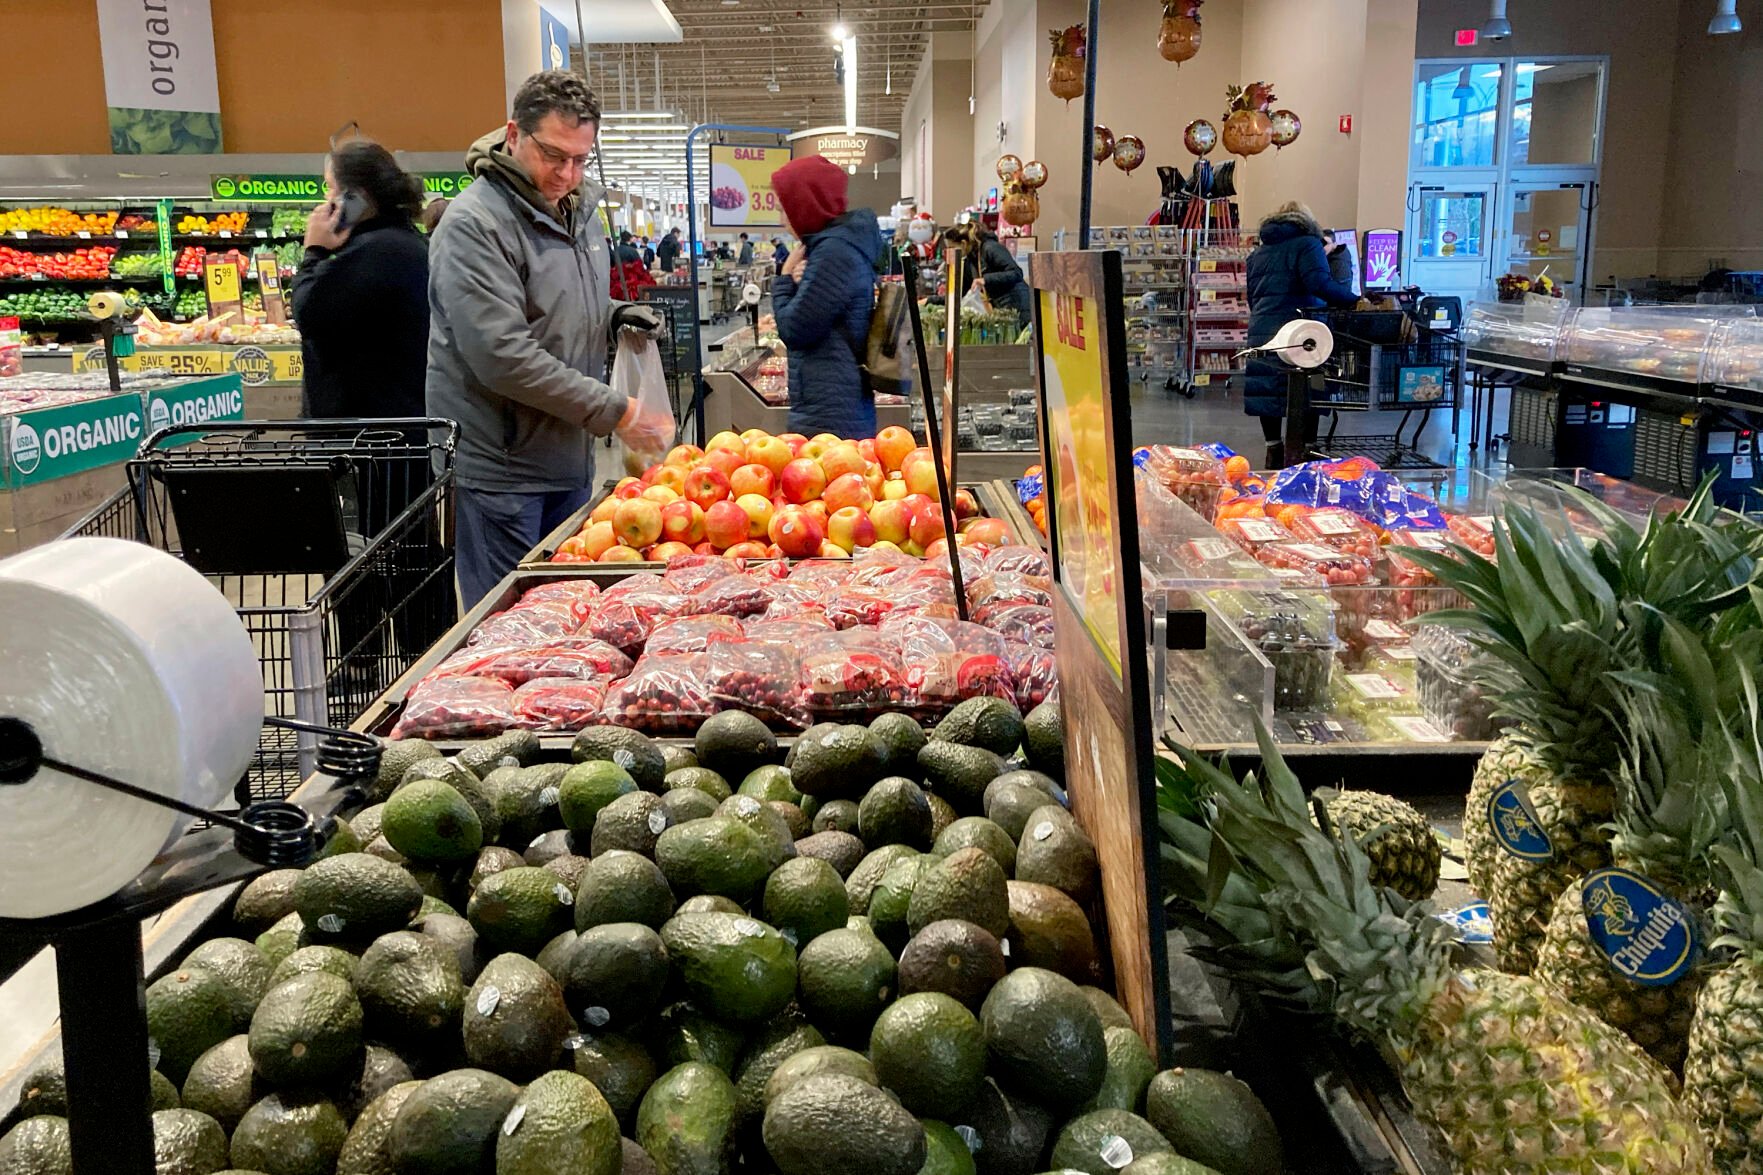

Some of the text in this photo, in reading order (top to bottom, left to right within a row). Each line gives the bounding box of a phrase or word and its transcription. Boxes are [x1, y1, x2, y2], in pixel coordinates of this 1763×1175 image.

[817, 137, 868, 151] pharmacy
[734, 148, 765, 161] SALE
[240, 180, 318, 195] ORGANIC
[751, 192, 781, 211] 3.9
[162, 221, 172, 274] ORGANIC
[1056, 293, 1086, 351] SALE
[140, 355, 164, 366] SAVE
[233, 358, 271, 373] VALUE
[289, 355, 303, 366] SA
[288, 366, 301, 377] UP
[172, 389, 242, 424] ORGANIC
[16, 434, 34, 448] USDA
[44, 412, 141, 459] ORGANIC
[1611, 902, 1681, 975] Chiquita
